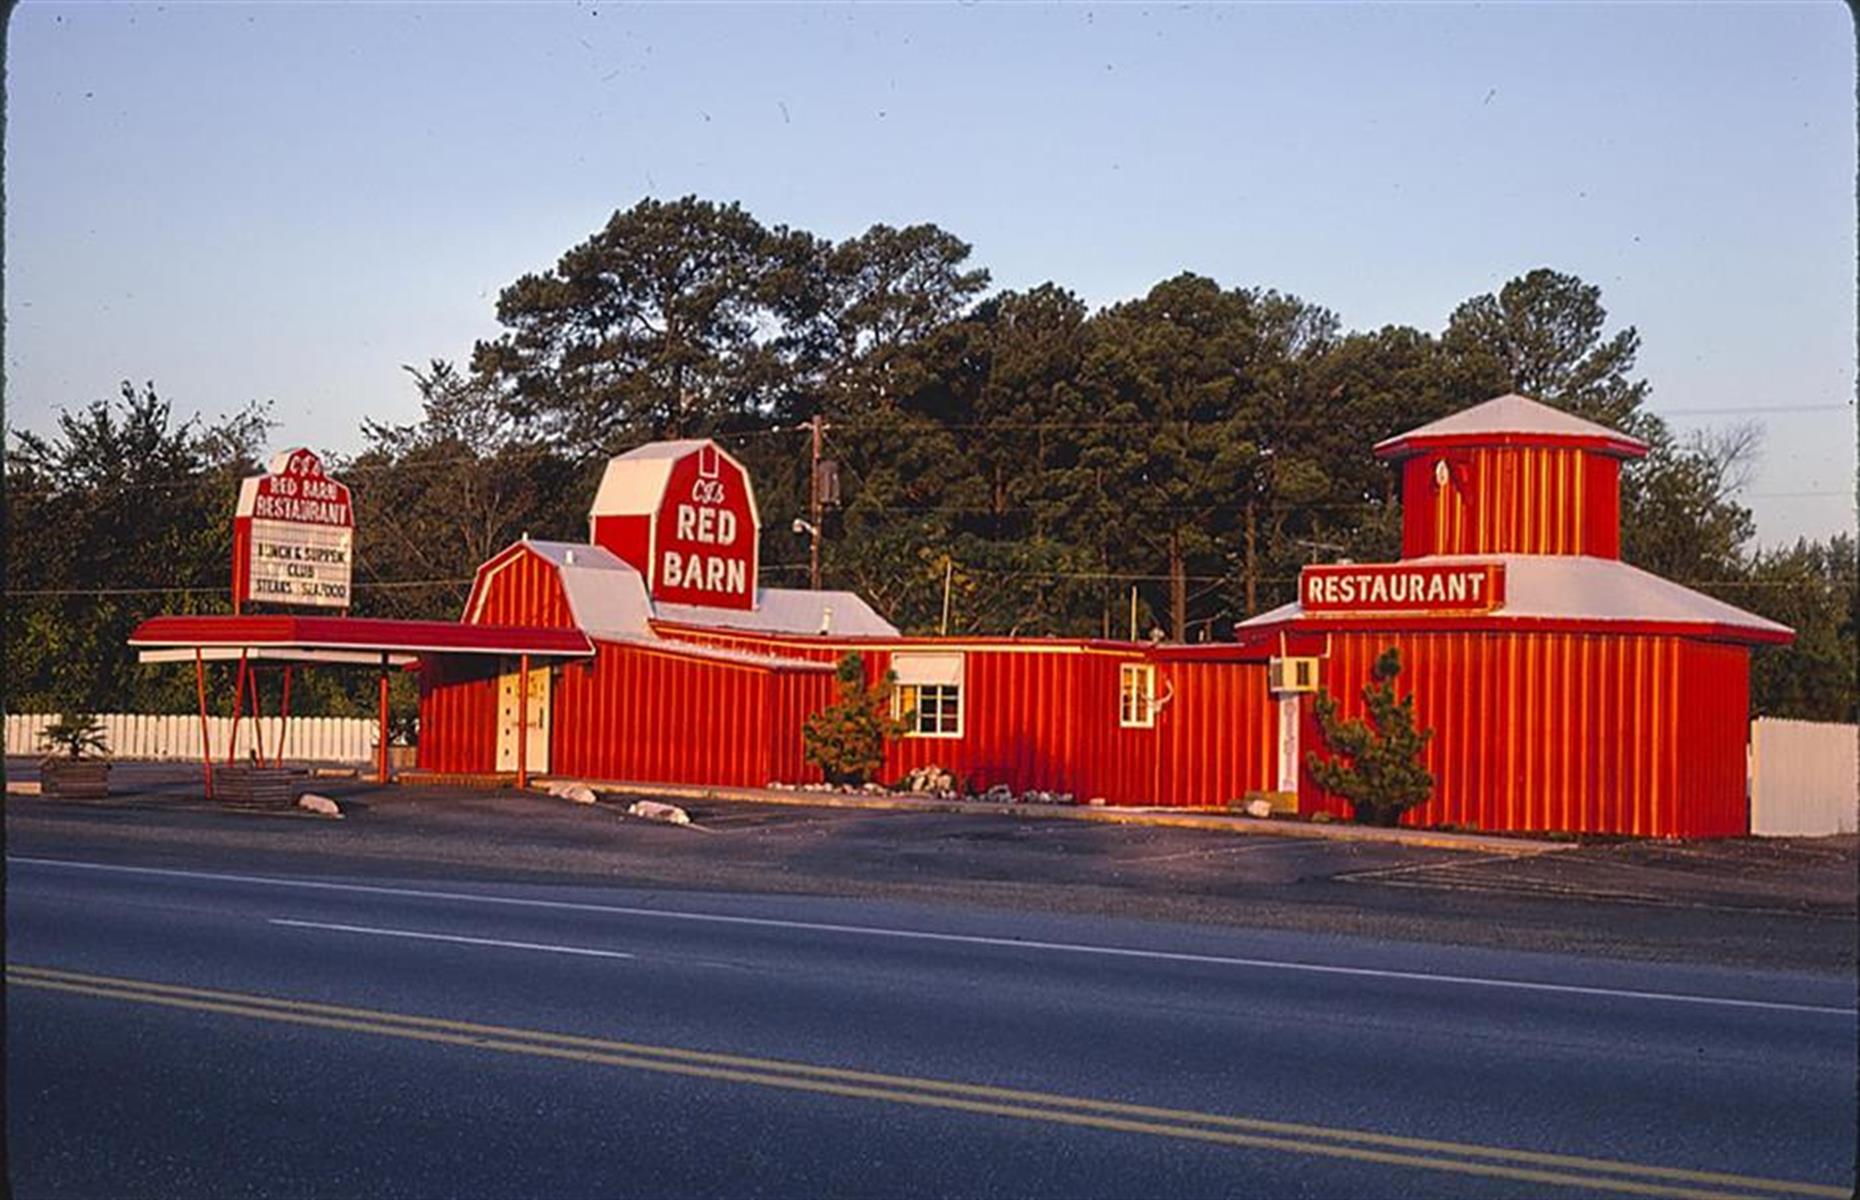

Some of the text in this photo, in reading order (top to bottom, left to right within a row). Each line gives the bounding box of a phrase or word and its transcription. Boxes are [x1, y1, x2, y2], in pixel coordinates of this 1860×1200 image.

[270, 476, 337, 500] RED BARN
[256, 495, 347, 524] RESTAURANT
[677, 504, 737, 546] RED
[304, 547, 345, 563] SUPPER
[287, 563, 314, 578] CLUB
[663, 550, 745, 595] BARN
[256, 578, 346, 598] STEAKS SEAFOOD
[1308, 572, 1485, 603] RESTAURANT
